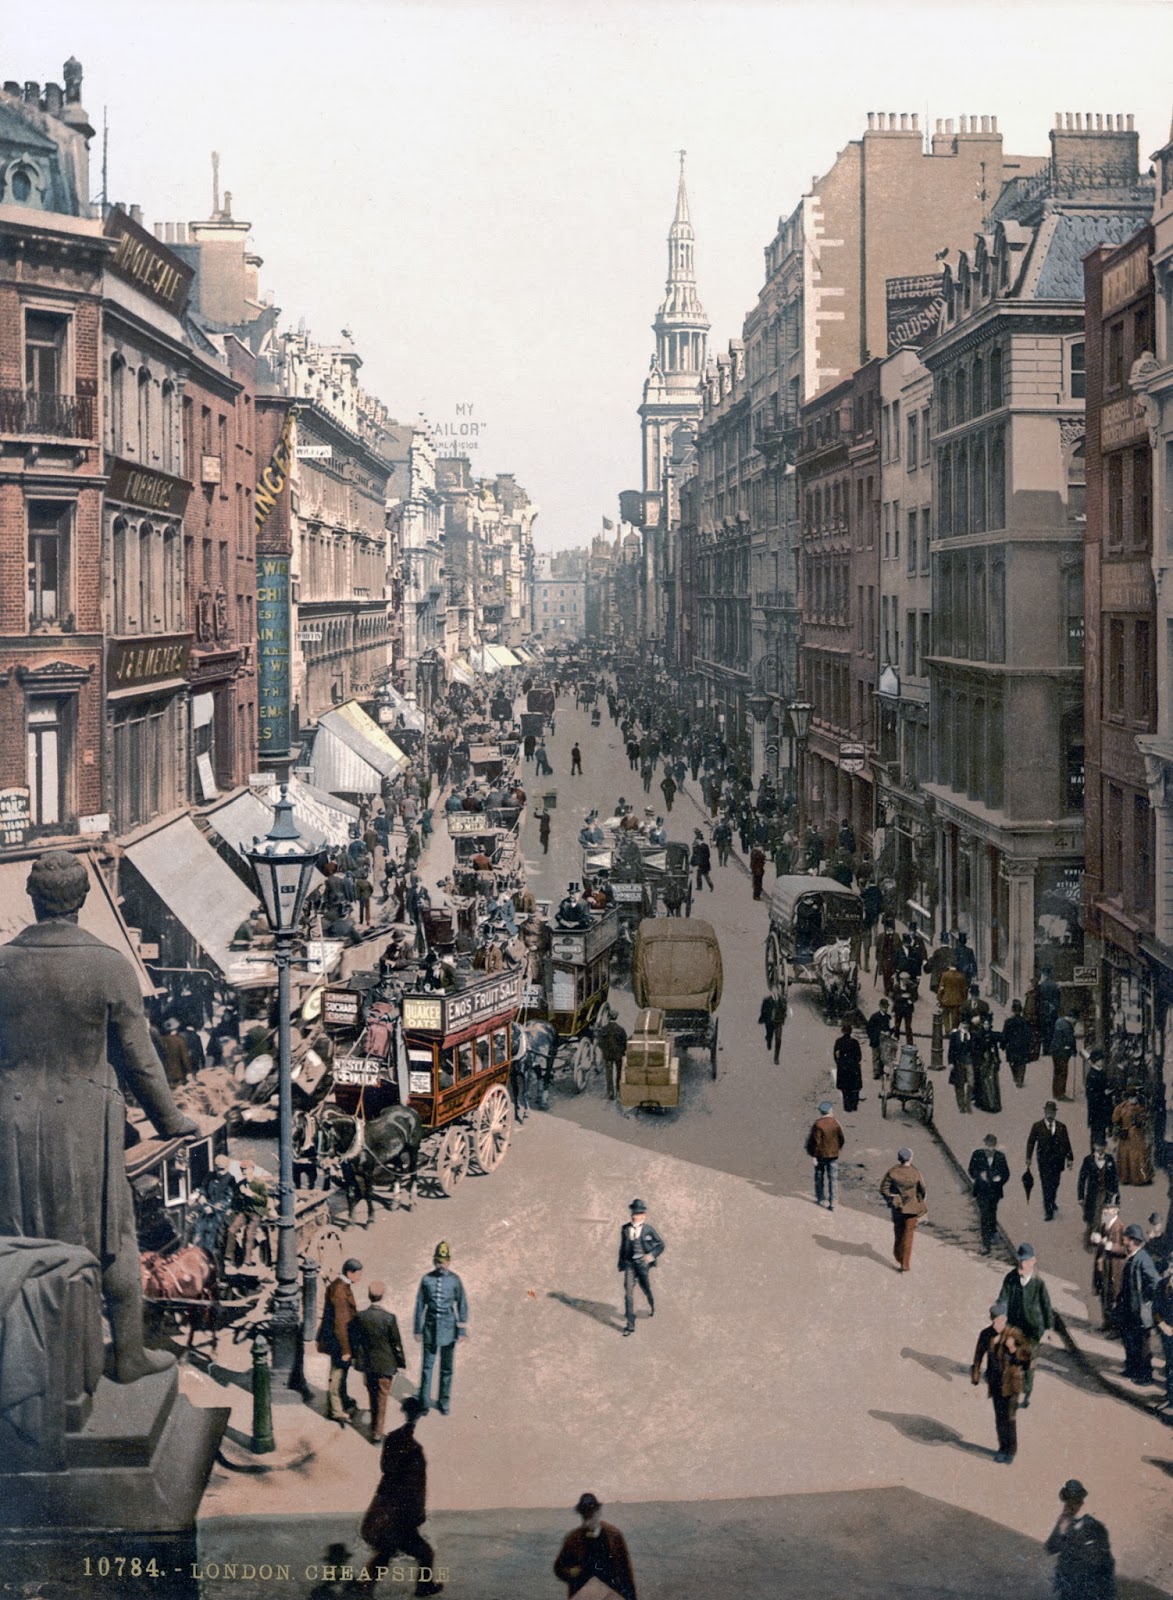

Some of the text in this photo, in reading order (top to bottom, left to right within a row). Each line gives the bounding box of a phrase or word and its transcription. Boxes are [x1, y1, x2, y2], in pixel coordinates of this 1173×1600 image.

[456, 402, 474, 416] MY
[434, 422, 487, 436] AILOR"
[1055, 837, 1076, 849] 41
[473, 987, 499, 1011] FRUIT
[500, 979, 519, 1001] SALT
[408, 1019, 437, 1029] OATS
